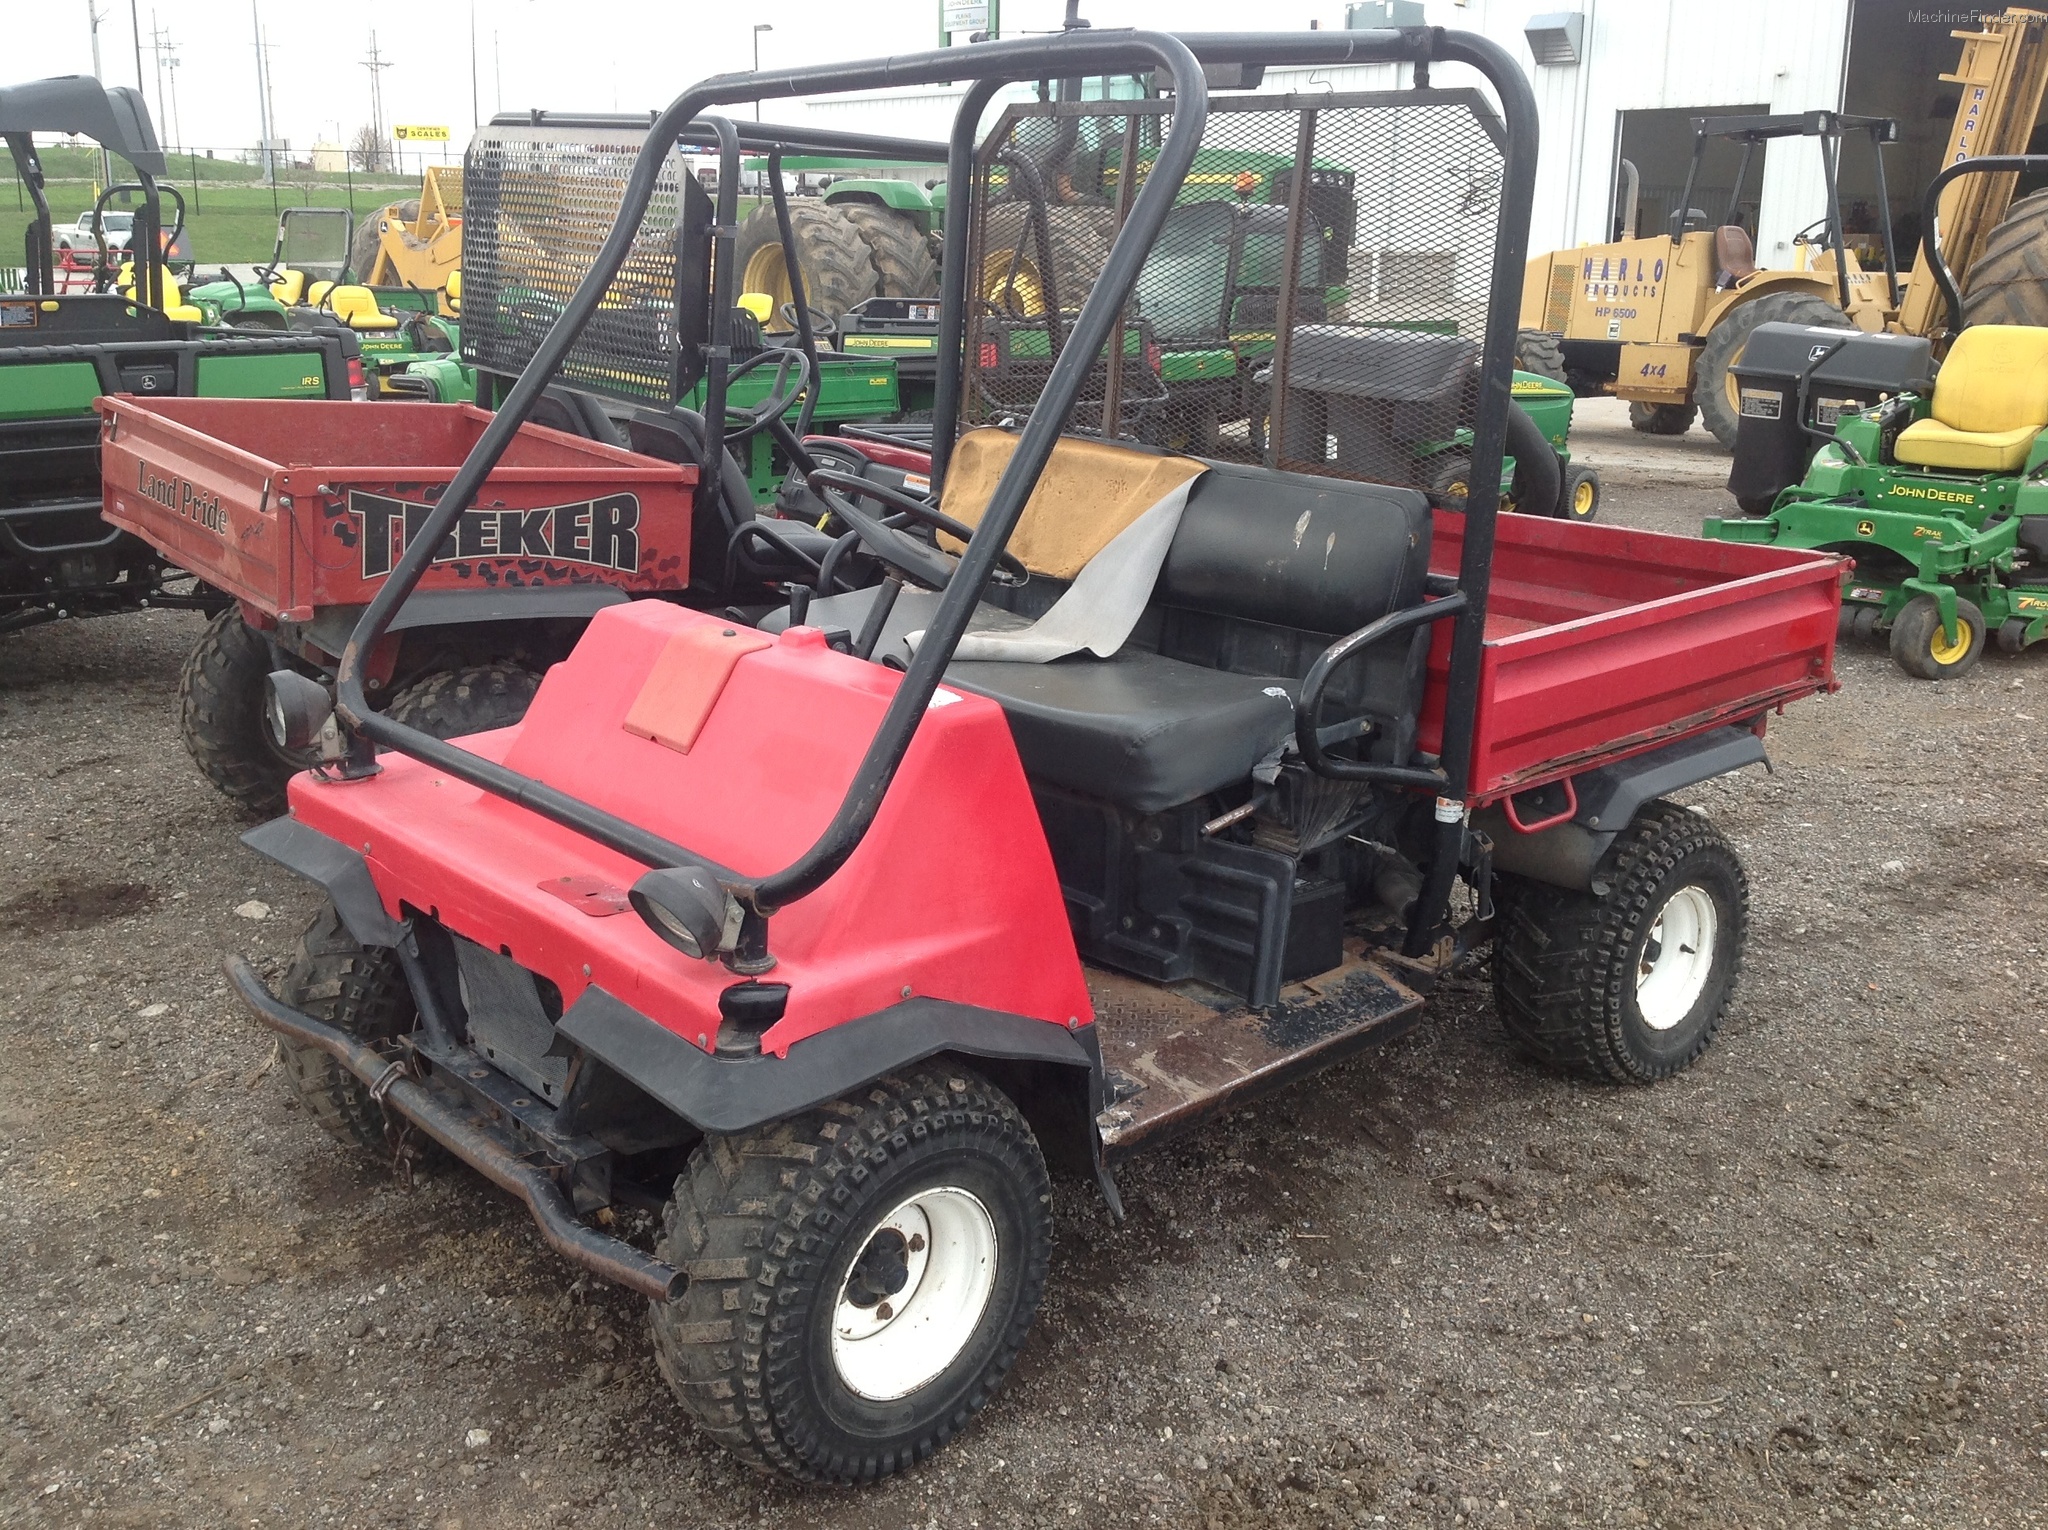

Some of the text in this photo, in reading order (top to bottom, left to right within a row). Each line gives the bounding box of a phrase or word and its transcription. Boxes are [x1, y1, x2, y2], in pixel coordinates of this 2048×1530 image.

[1955, 88, 1985, 162] HARLO
[1583, 258, 1664, 282] HARLO
[1584, 284, 1656, 298] PRODUCTS
[1595, 307, 1637, 319] HP 6500
[361, 343, 379, 351] JOHN
[301, 376, 320, 386] IRS
[137, 459, 178, 511] Land
[180, 480, 229, 536] Pride
[1888, 484, 1974, 504] JOHN DEERE
[2017, 596, 2048, 609] 7IRO
